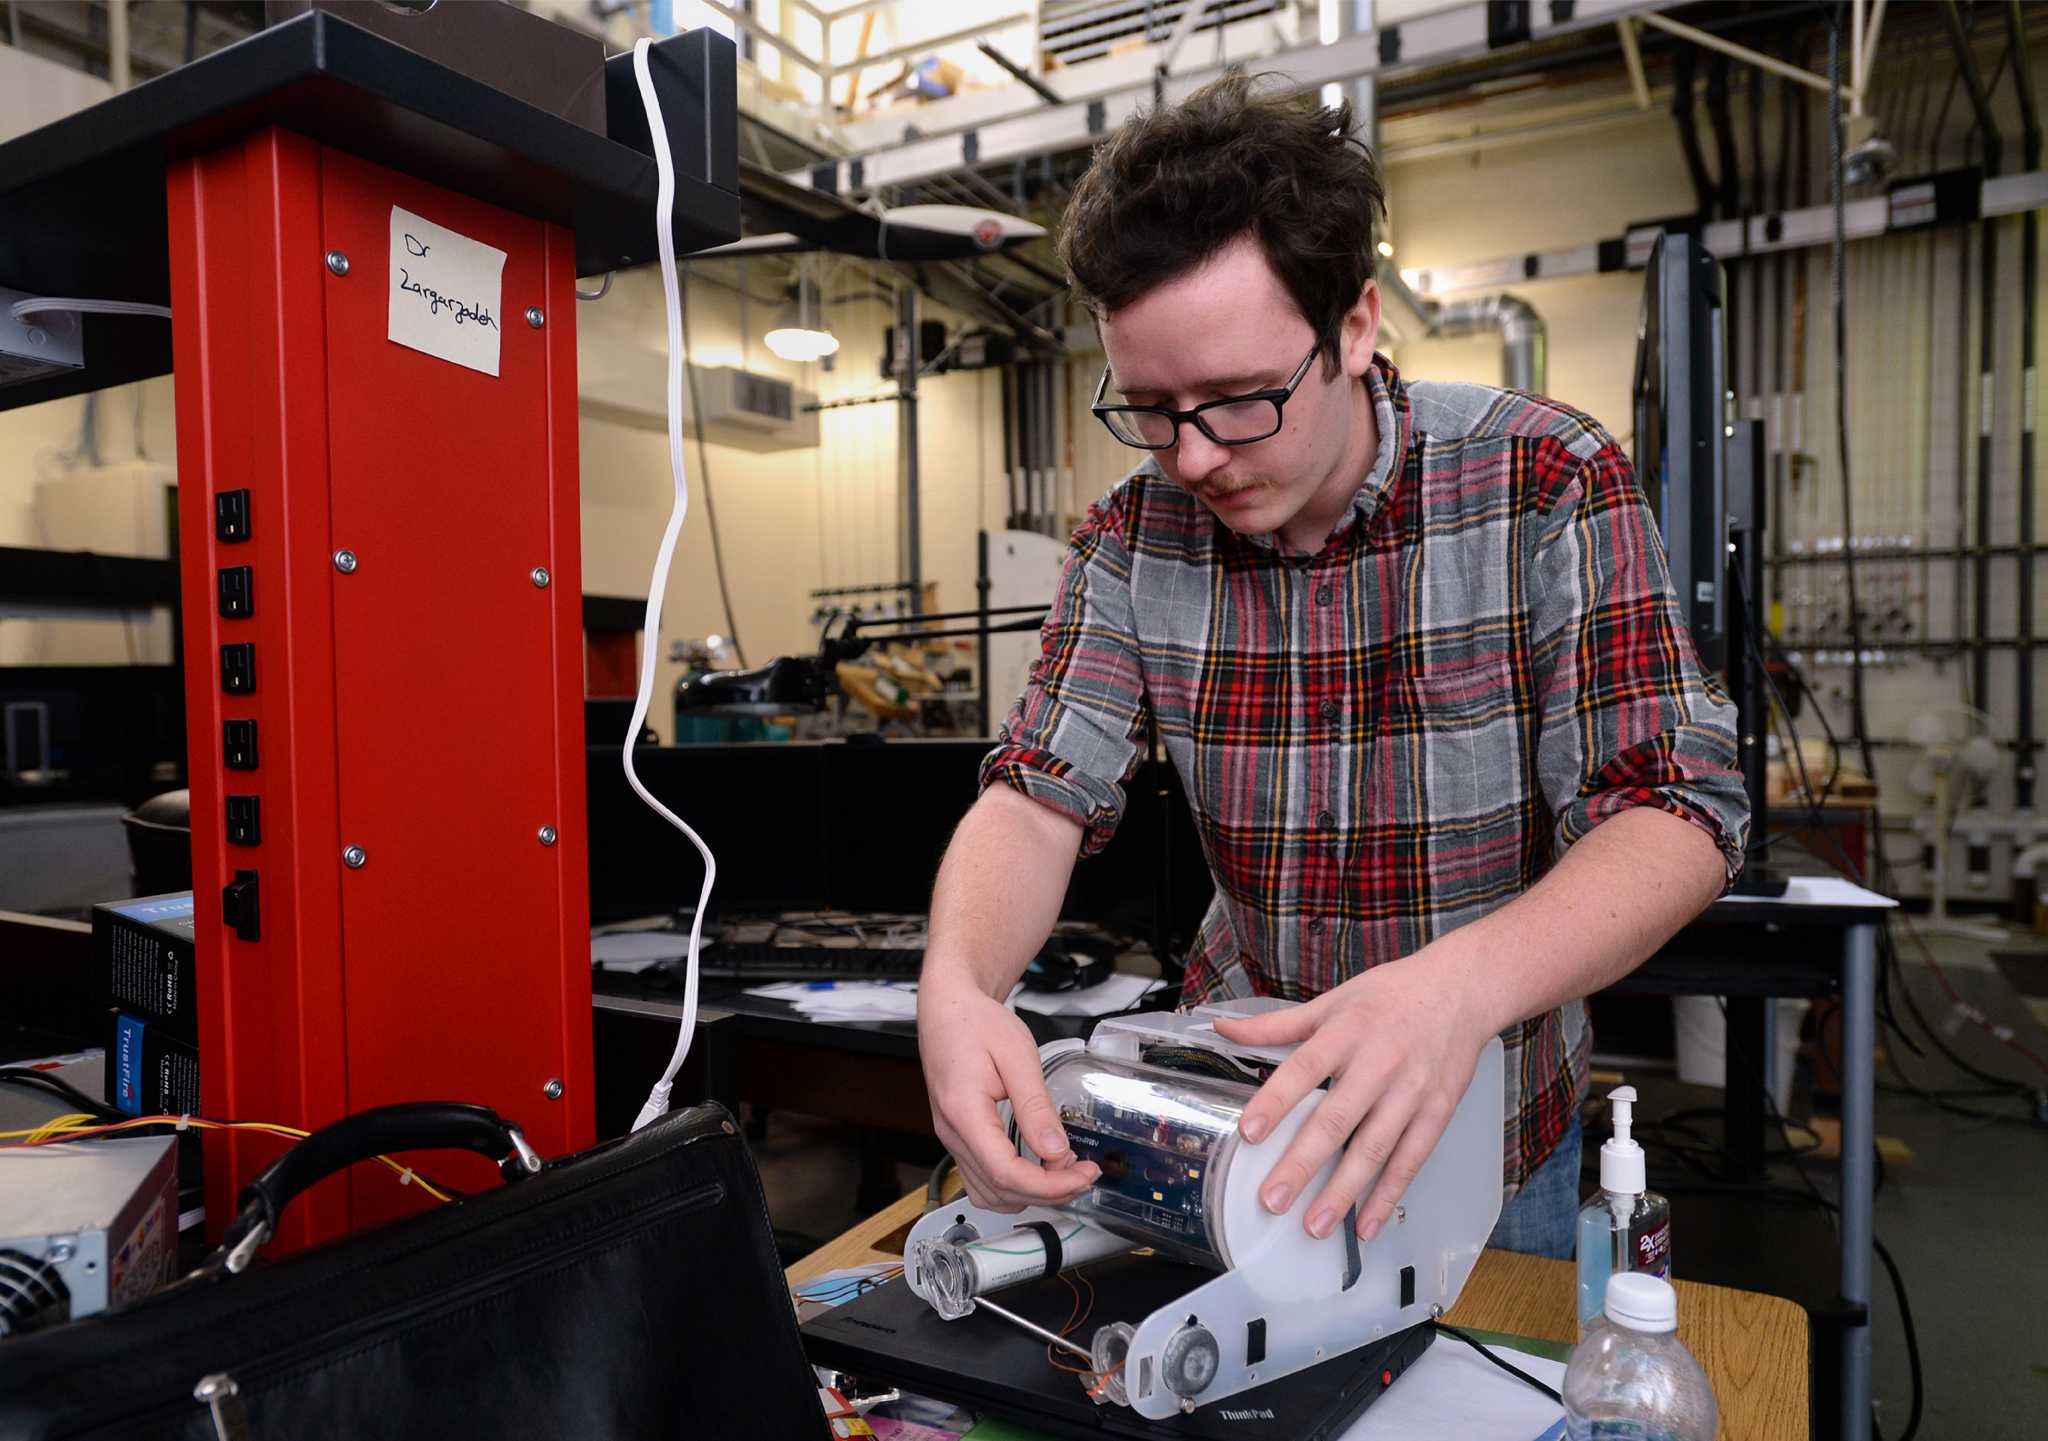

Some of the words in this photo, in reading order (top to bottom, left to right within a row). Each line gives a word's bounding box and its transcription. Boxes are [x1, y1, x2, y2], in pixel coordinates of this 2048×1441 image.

[404, 233, 431, 258] Dr
[122, 1028, 132, 1099] TrustFire
[1219, 1408, 1275, 1422] ThinkPad
